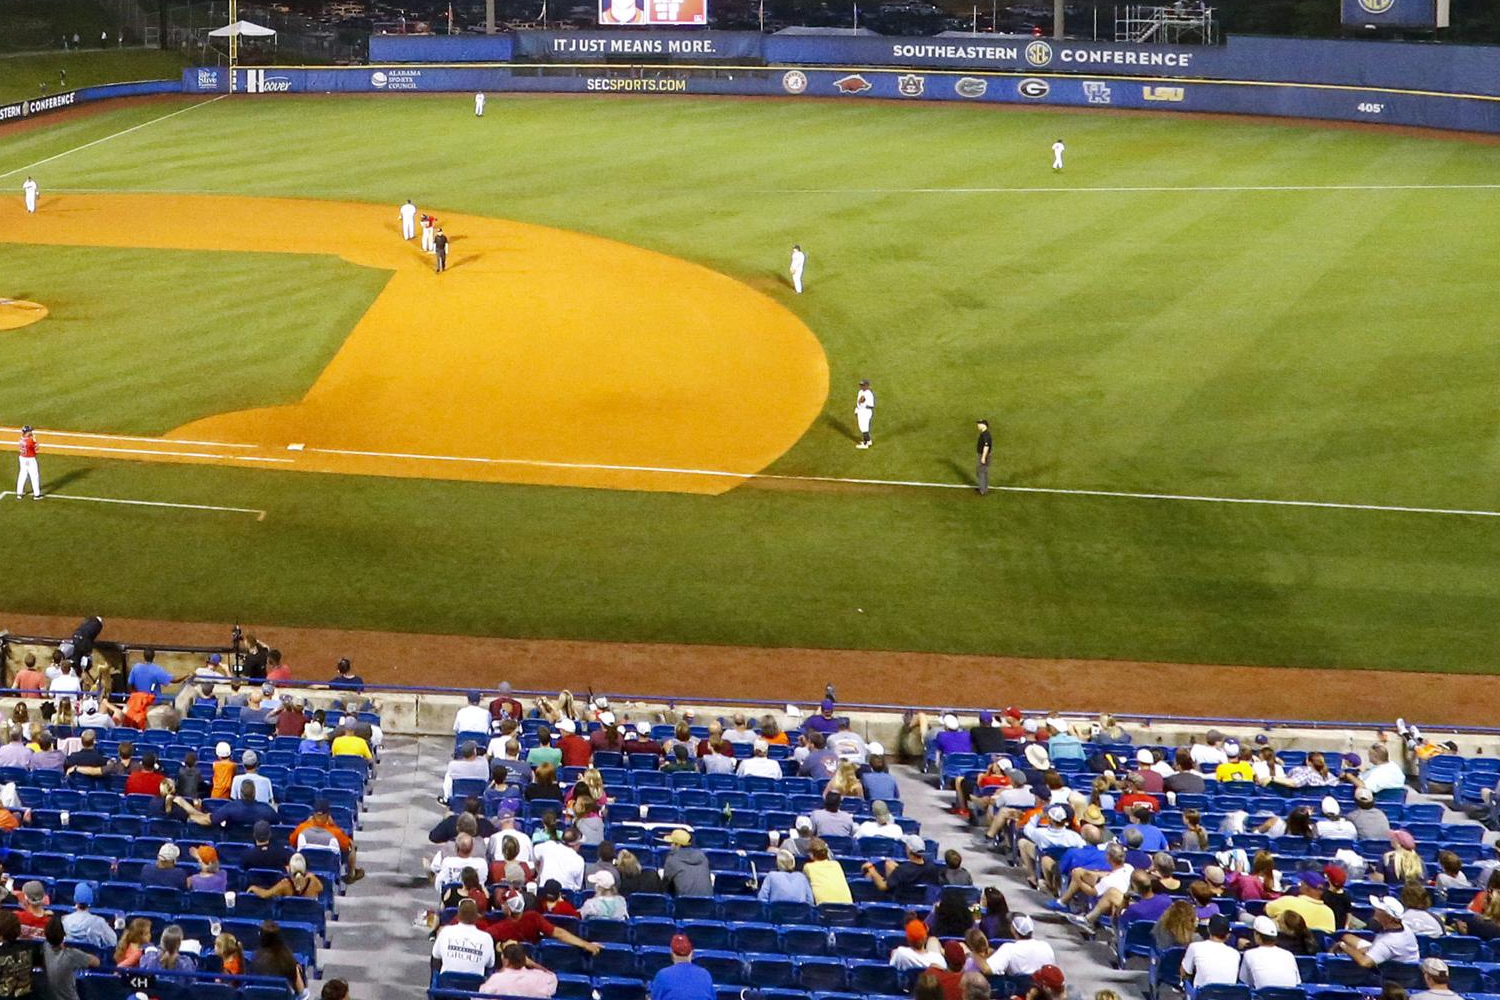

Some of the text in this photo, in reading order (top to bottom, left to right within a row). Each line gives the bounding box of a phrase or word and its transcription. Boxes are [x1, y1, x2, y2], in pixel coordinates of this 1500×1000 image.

[553, 39, 717, 54] IT JUST MEANS MORE.
[892, 44, 1018, 60] SOUTHEASTERN
[1028, 43, 1050, 66] SEC
[1060, 49, 1190, 67] CONFERENCE
[247, 69, 293, 93] Hoover
[587, 78, 686, 91] SECSPORTS.COM
[1142, 86, 1185, 102] LSU
[30, 92, 76, 113] CONFERENCE
[1357, 102, 1385, 114] 405'
[446, 951, 483, 963] GROUP
